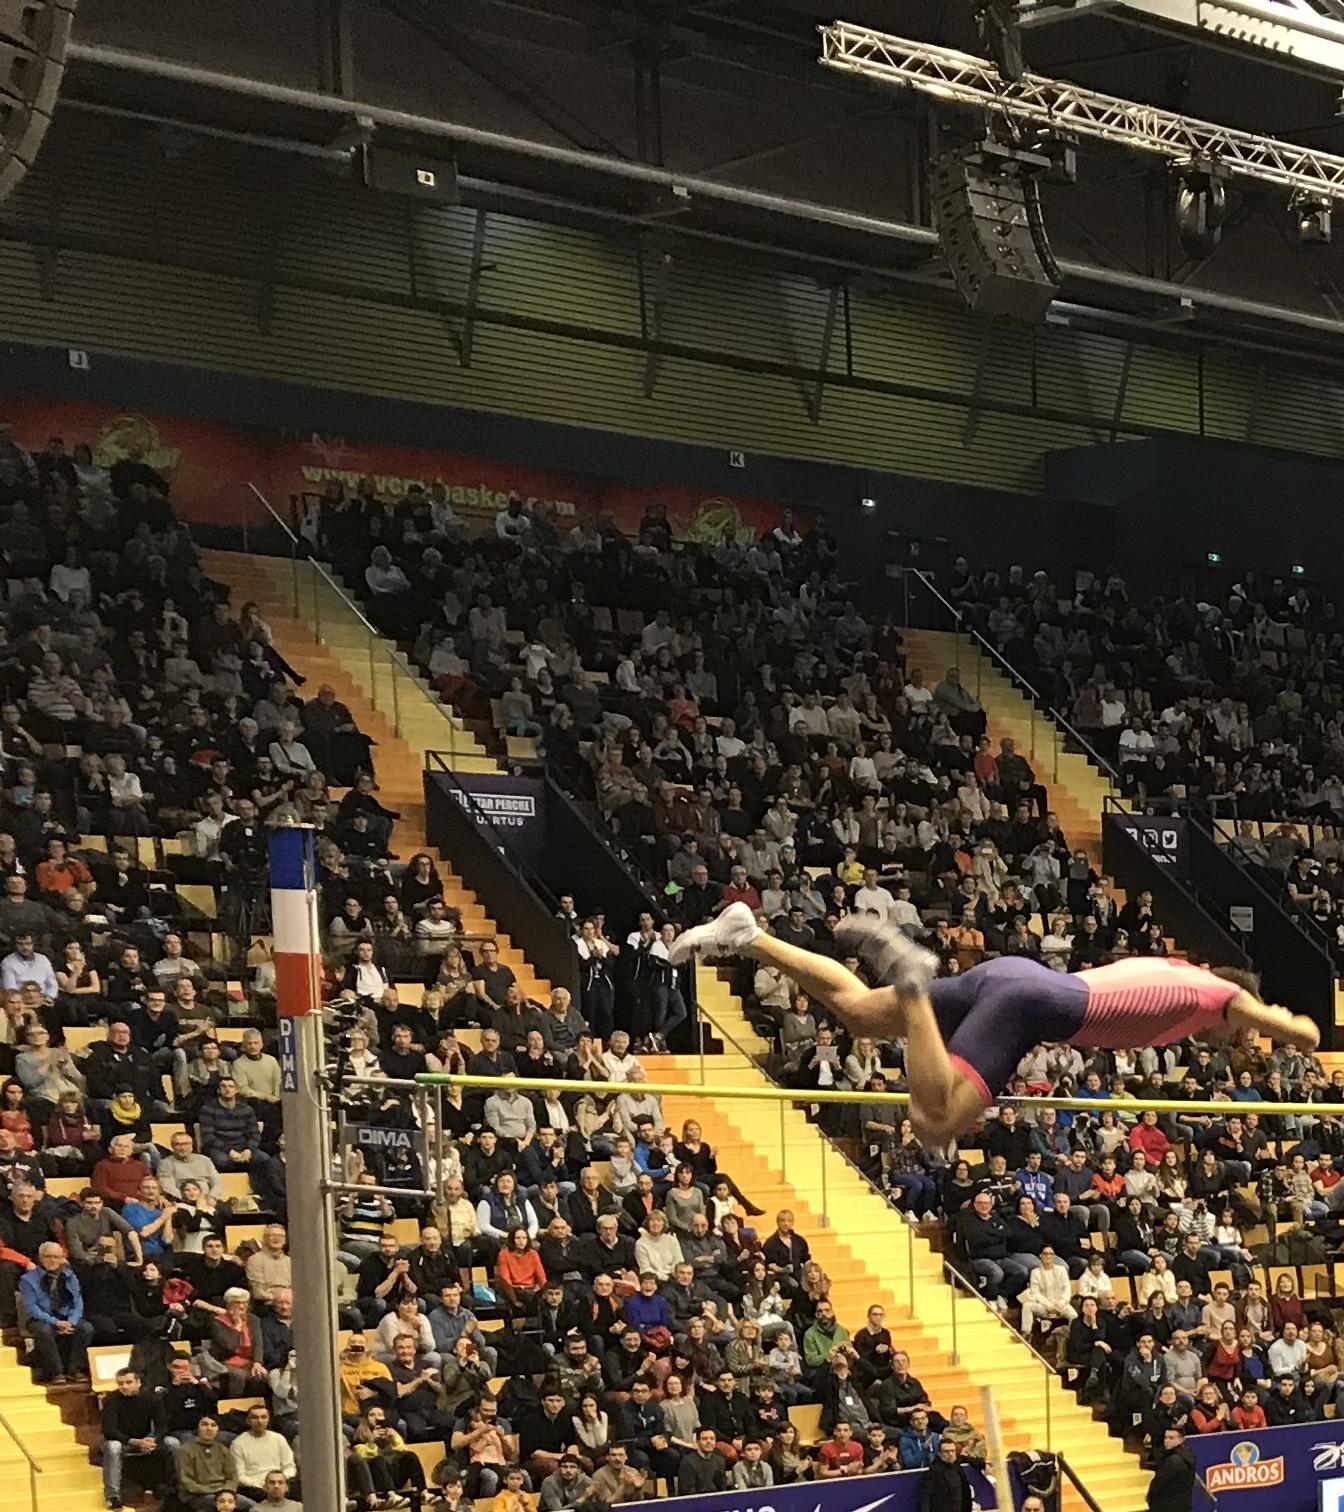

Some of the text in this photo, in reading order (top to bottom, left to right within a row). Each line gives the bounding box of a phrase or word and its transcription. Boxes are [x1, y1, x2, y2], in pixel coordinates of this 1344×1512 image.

[280, 1018, 295, 1089] DIMA
[358, 1128, 412, 1148] DIMA
[1210, 1462, 1280, 1486] ANDROS
